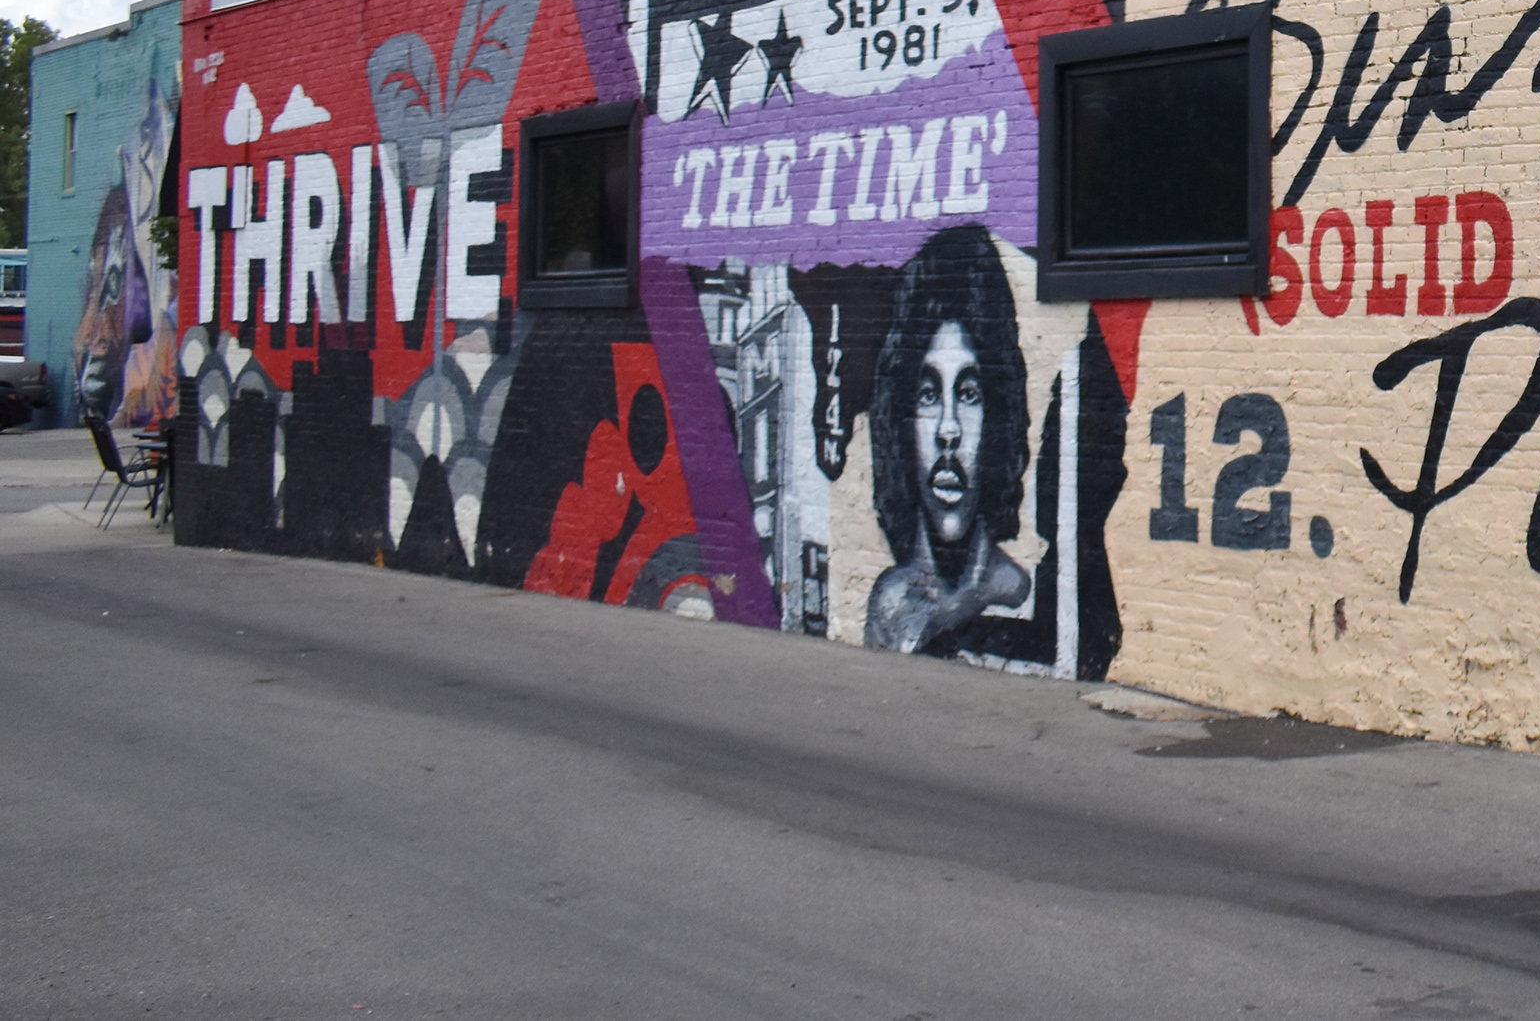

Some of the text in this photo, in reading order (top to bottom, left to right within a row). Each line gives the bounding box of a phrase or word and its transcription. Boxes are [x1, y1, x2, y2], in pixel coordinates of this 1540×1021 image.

[860, 23, 941, 71] 1981
[187, 123, 503, 324] THRIVE
[1148, 391, 1334, 559] 12.
